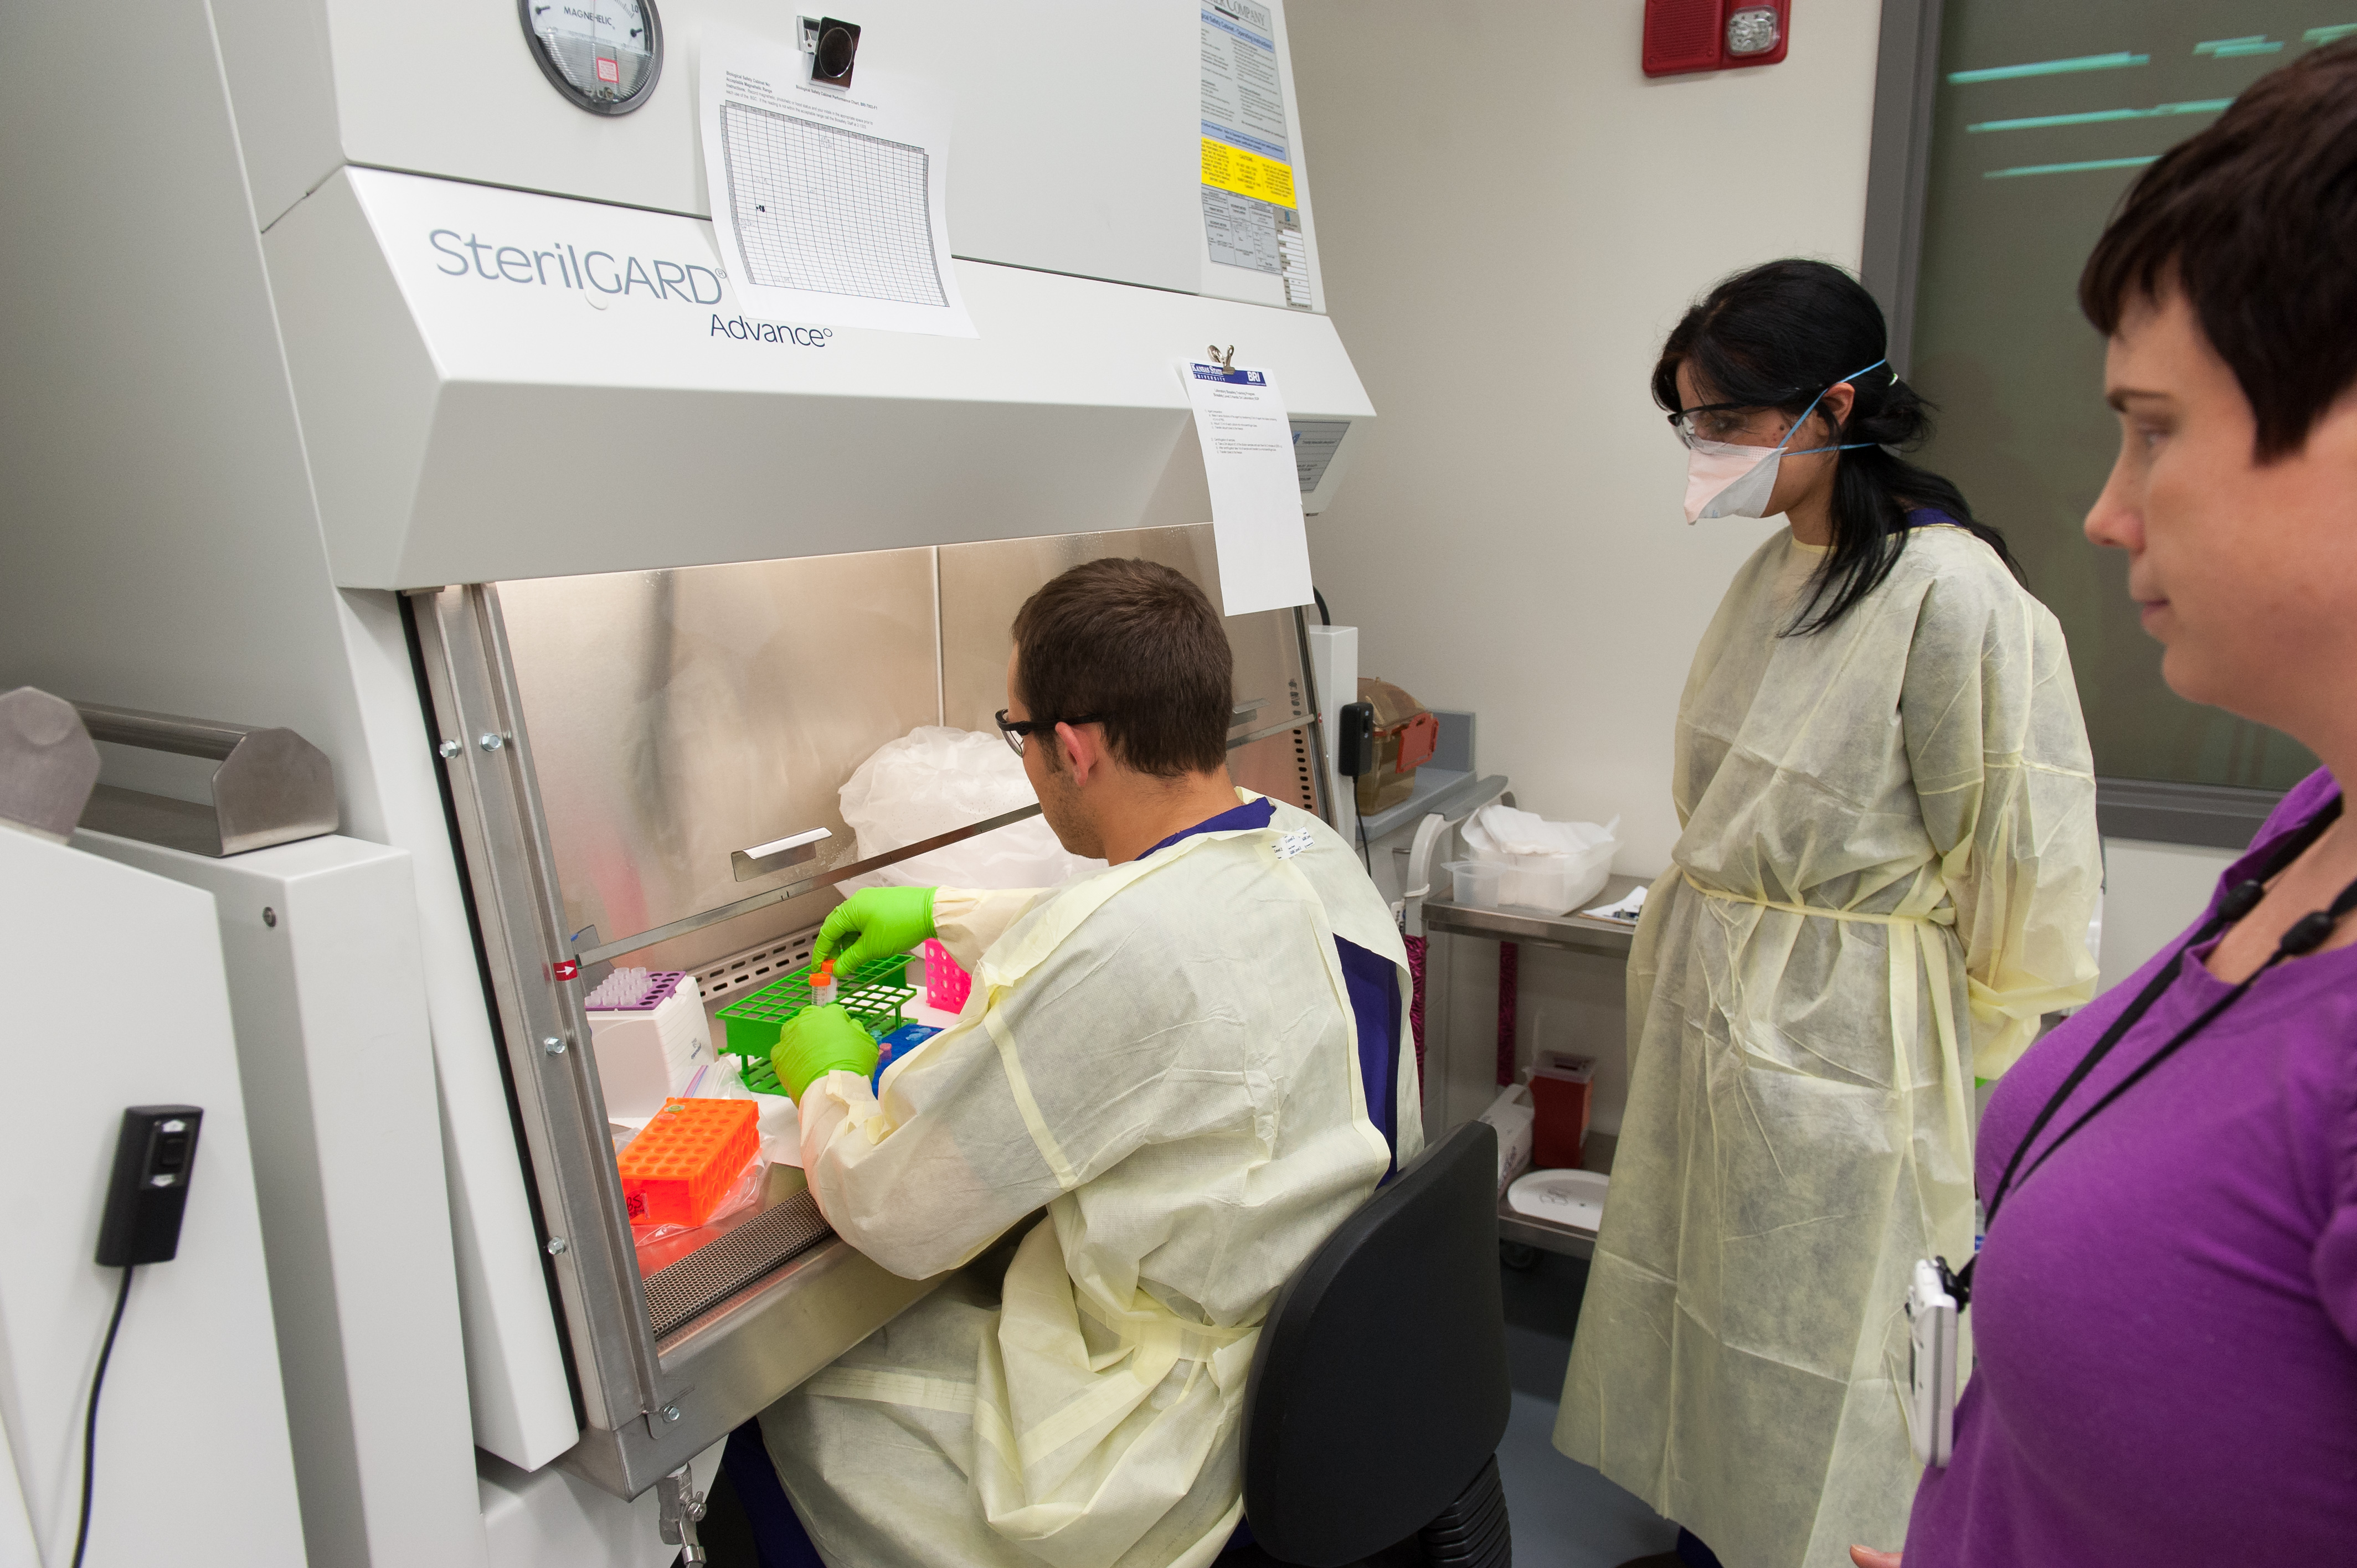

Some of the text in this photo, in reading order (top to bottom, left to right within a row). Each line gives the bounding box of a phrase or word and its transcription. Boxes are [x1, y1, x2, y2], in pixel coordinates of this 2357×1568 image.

[564, 6, 612, 25] MAGNEHELIC
[726, 70, 742, 79] Biological
[1190, 363, 1223, 375] KANSAS STATE
[1194, 374, 1226, 382] UNIVERSITY
[1247, 371, 1260, 382] BRI
